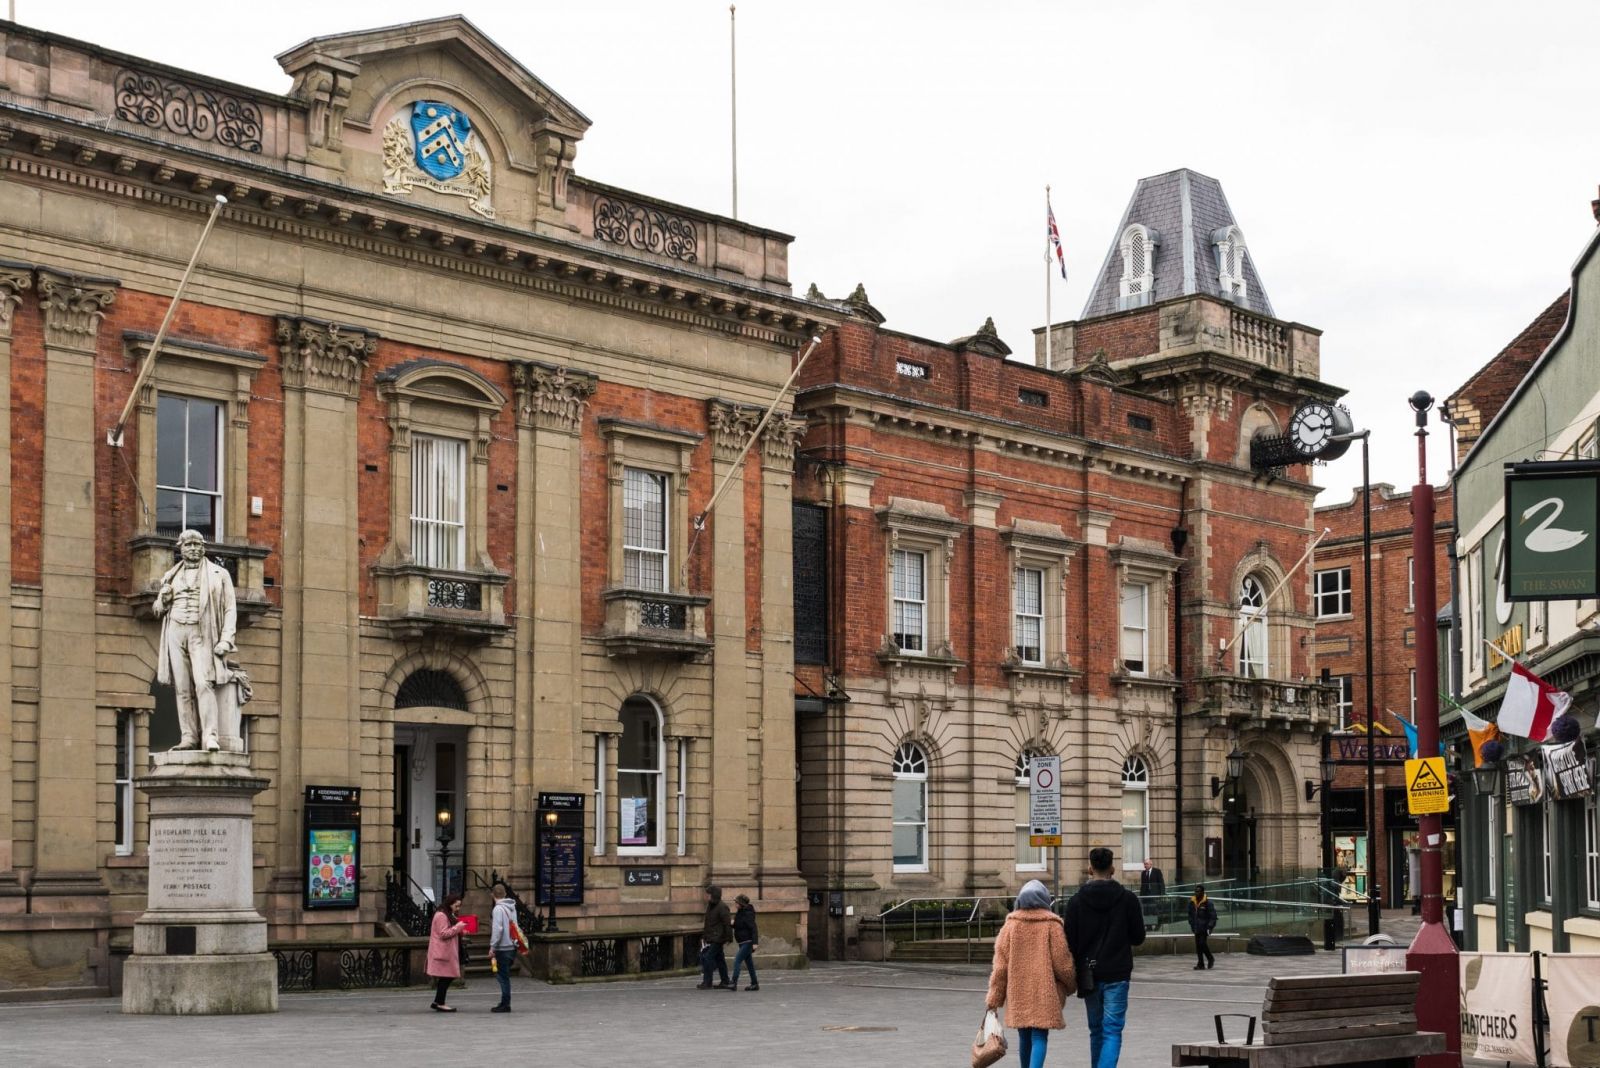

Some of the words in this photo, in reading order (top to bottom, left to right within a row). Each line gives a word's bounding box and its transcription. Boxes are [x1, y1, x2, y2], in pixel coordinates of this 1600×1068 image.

[1522, 579, 1547, 592] THE
[1550, 578, 1586, 591] SWAN
[1411, 790, 1445, 798] WARNING
[1461, 1013, 1517, 1040] HATCHERS
